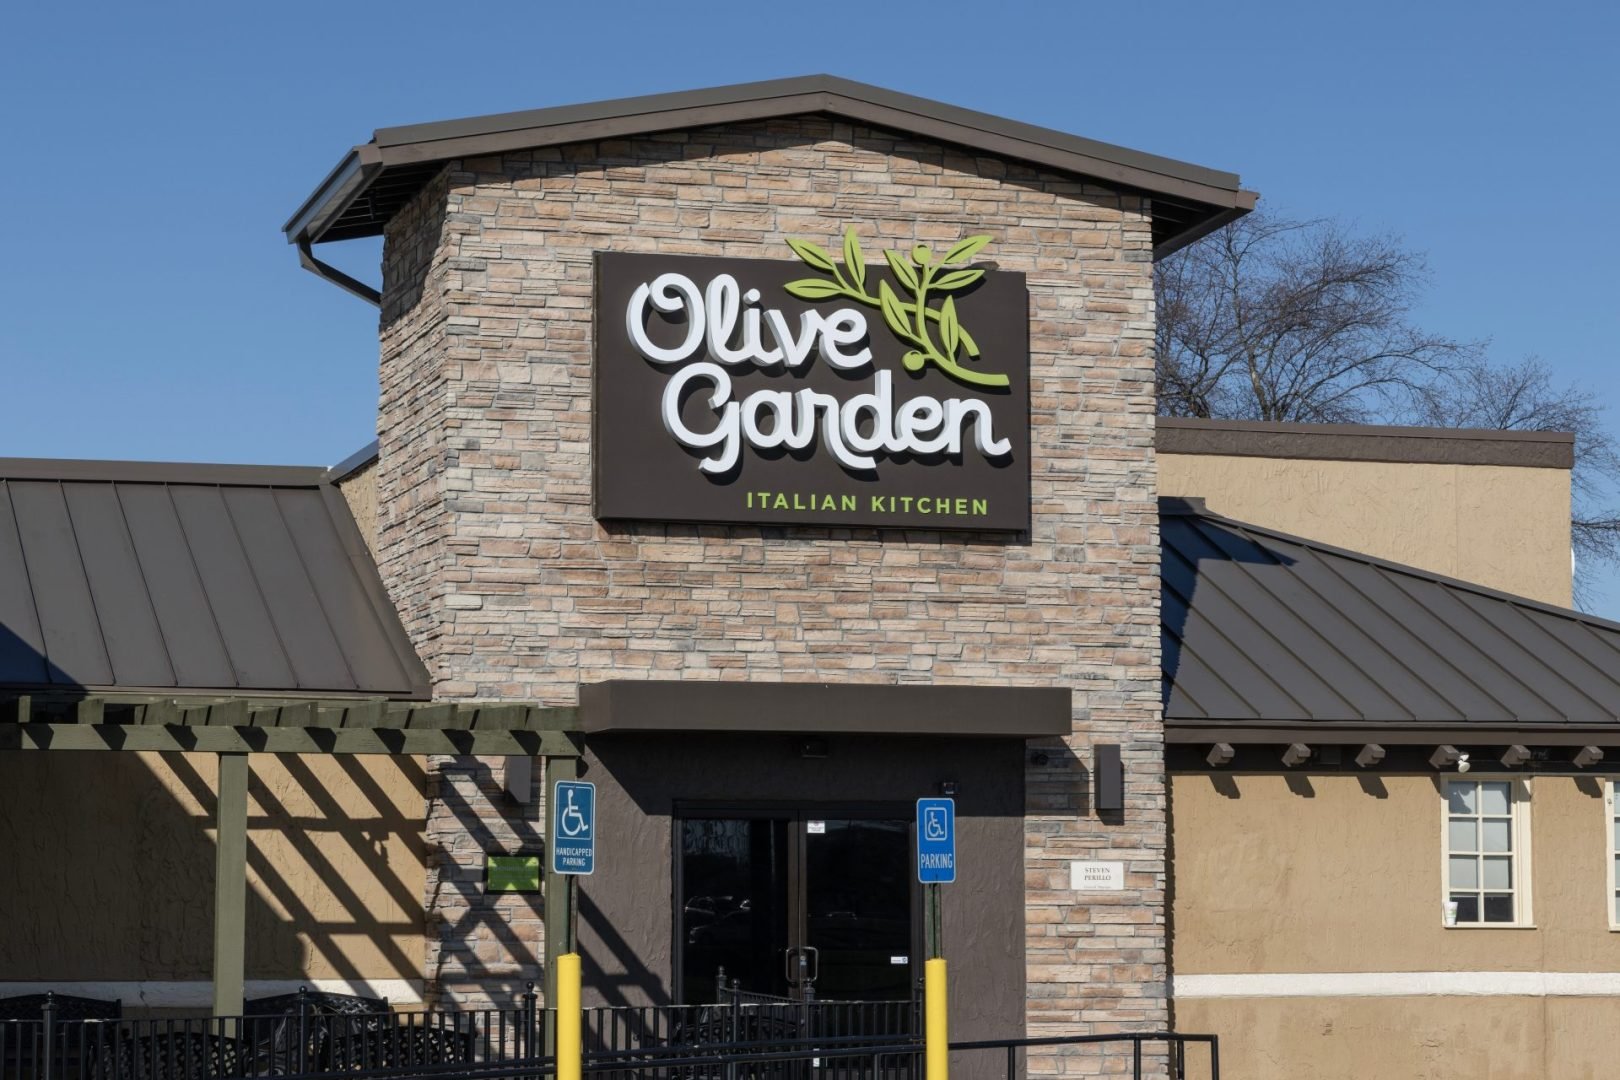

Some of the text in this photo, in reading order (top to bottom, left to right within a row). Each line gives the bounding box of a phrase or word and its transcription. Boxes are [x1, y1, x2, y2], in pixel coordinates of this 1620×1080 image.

[625, 272, 873, 370] Olive
[661, 362, 1012, 475] Garden
[747, 492, 988, 516] ITALIAN KITCHEN
[555, 847, 593, 857] HANDICAPPED
[562, 857, 586, 867] PARKING
[920, 853, 953, 869] PARKING
